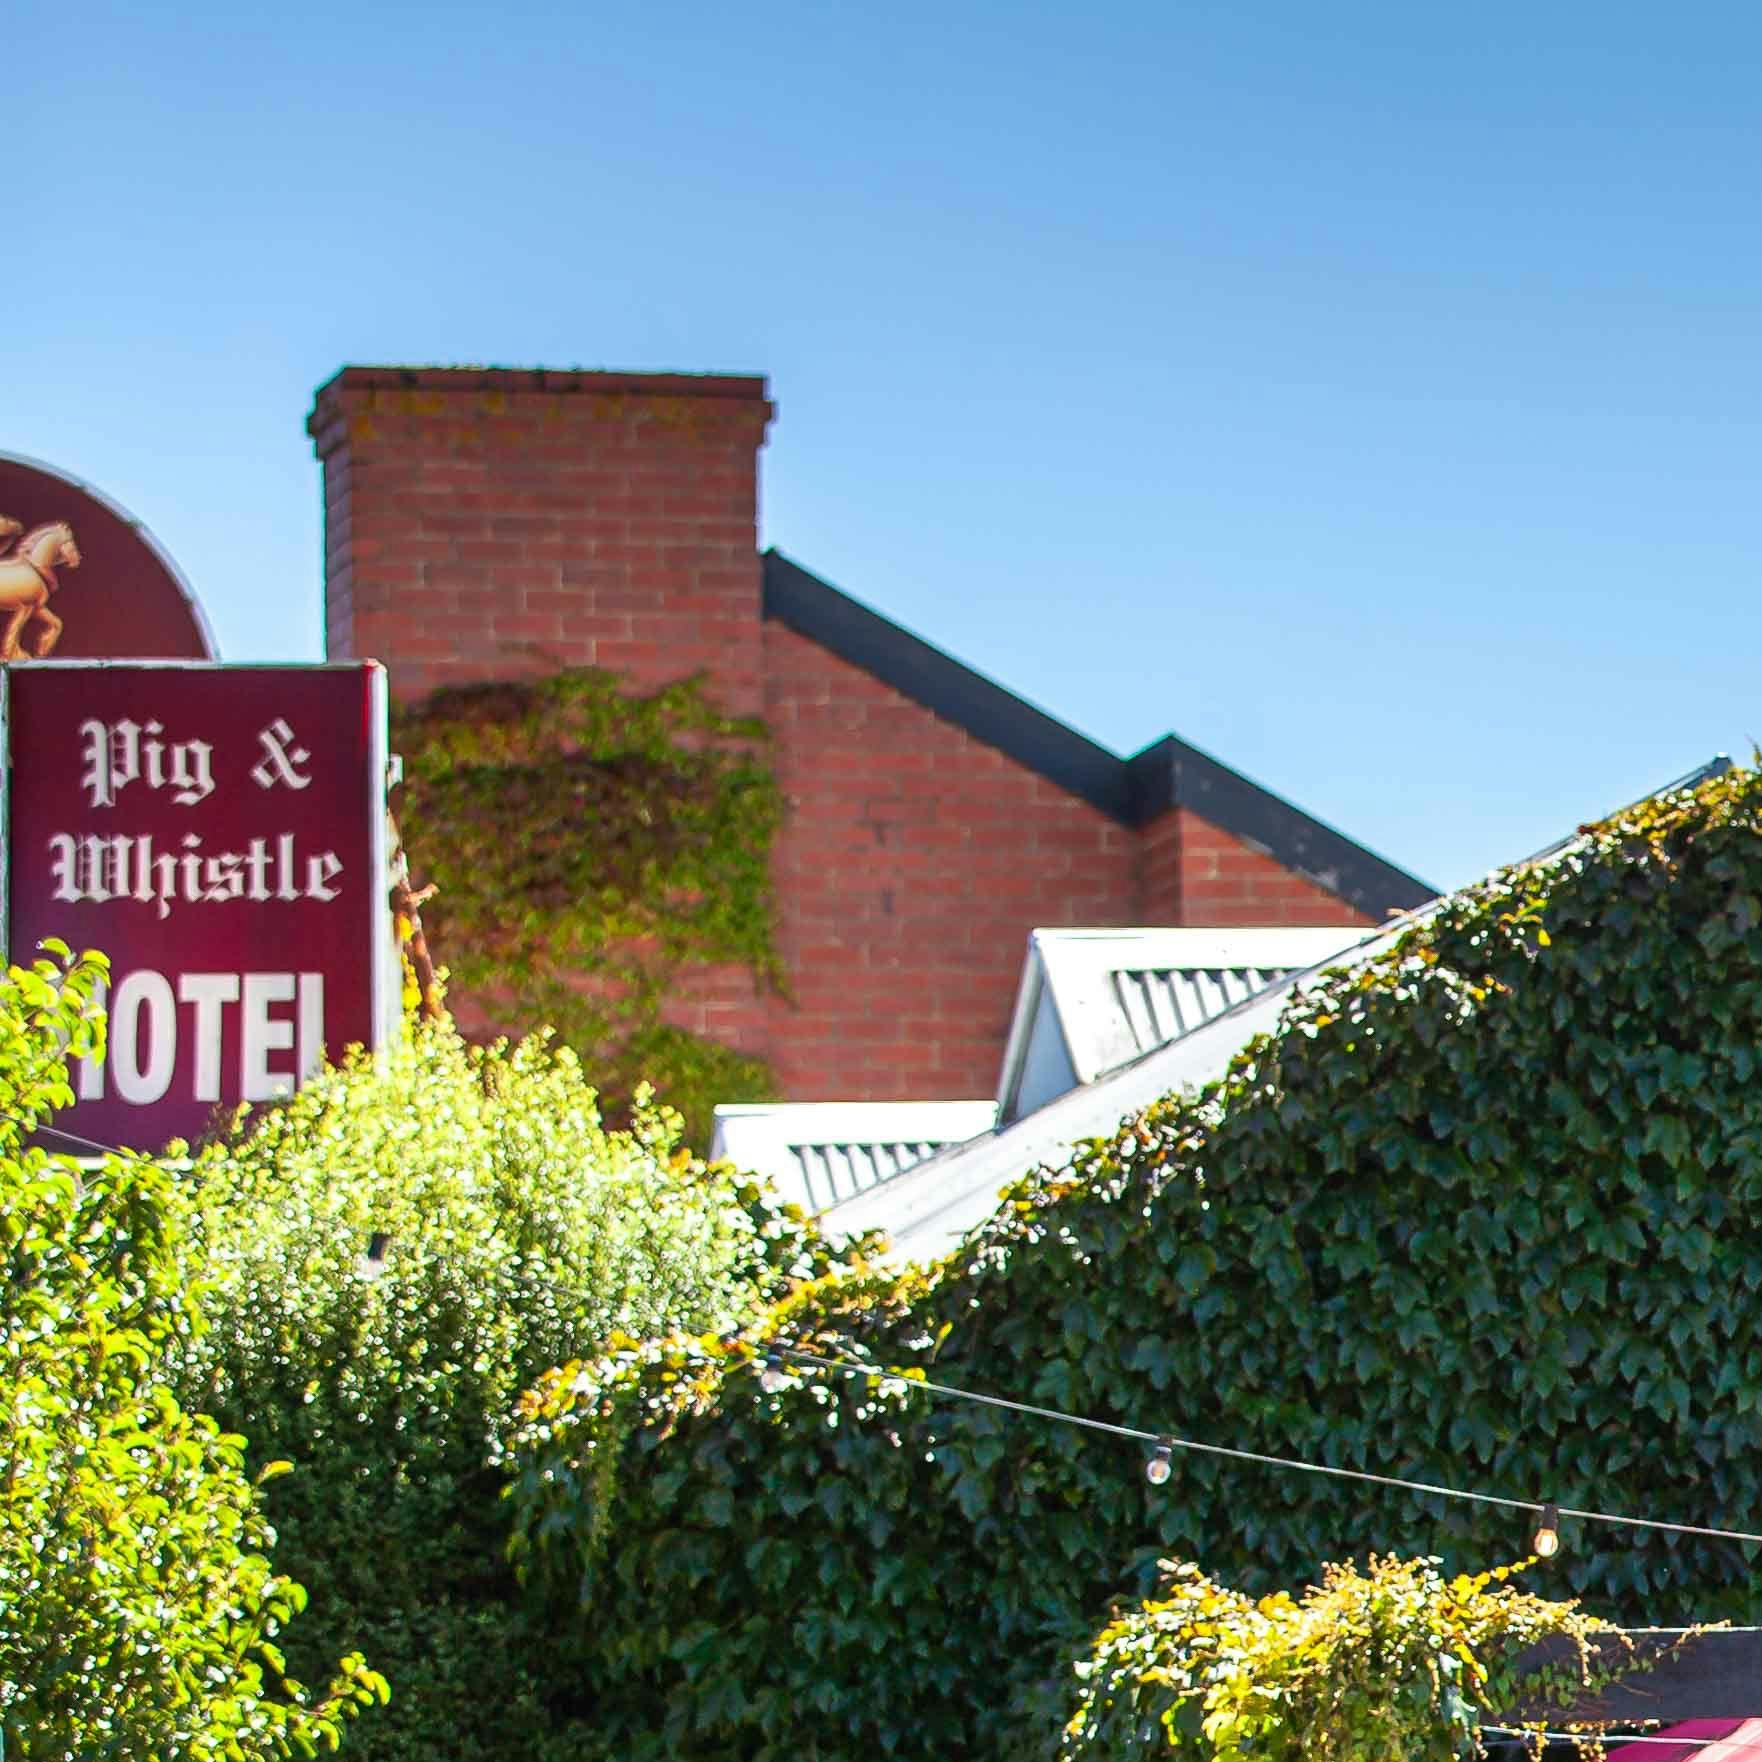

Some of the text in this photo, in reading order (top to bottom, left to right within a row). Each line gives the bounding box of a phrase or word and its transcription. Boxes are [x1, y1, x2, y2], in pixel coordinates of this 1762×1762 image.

[80, 717, 312, 808] Pig &
[48, 832, 344, 919] Whistle
